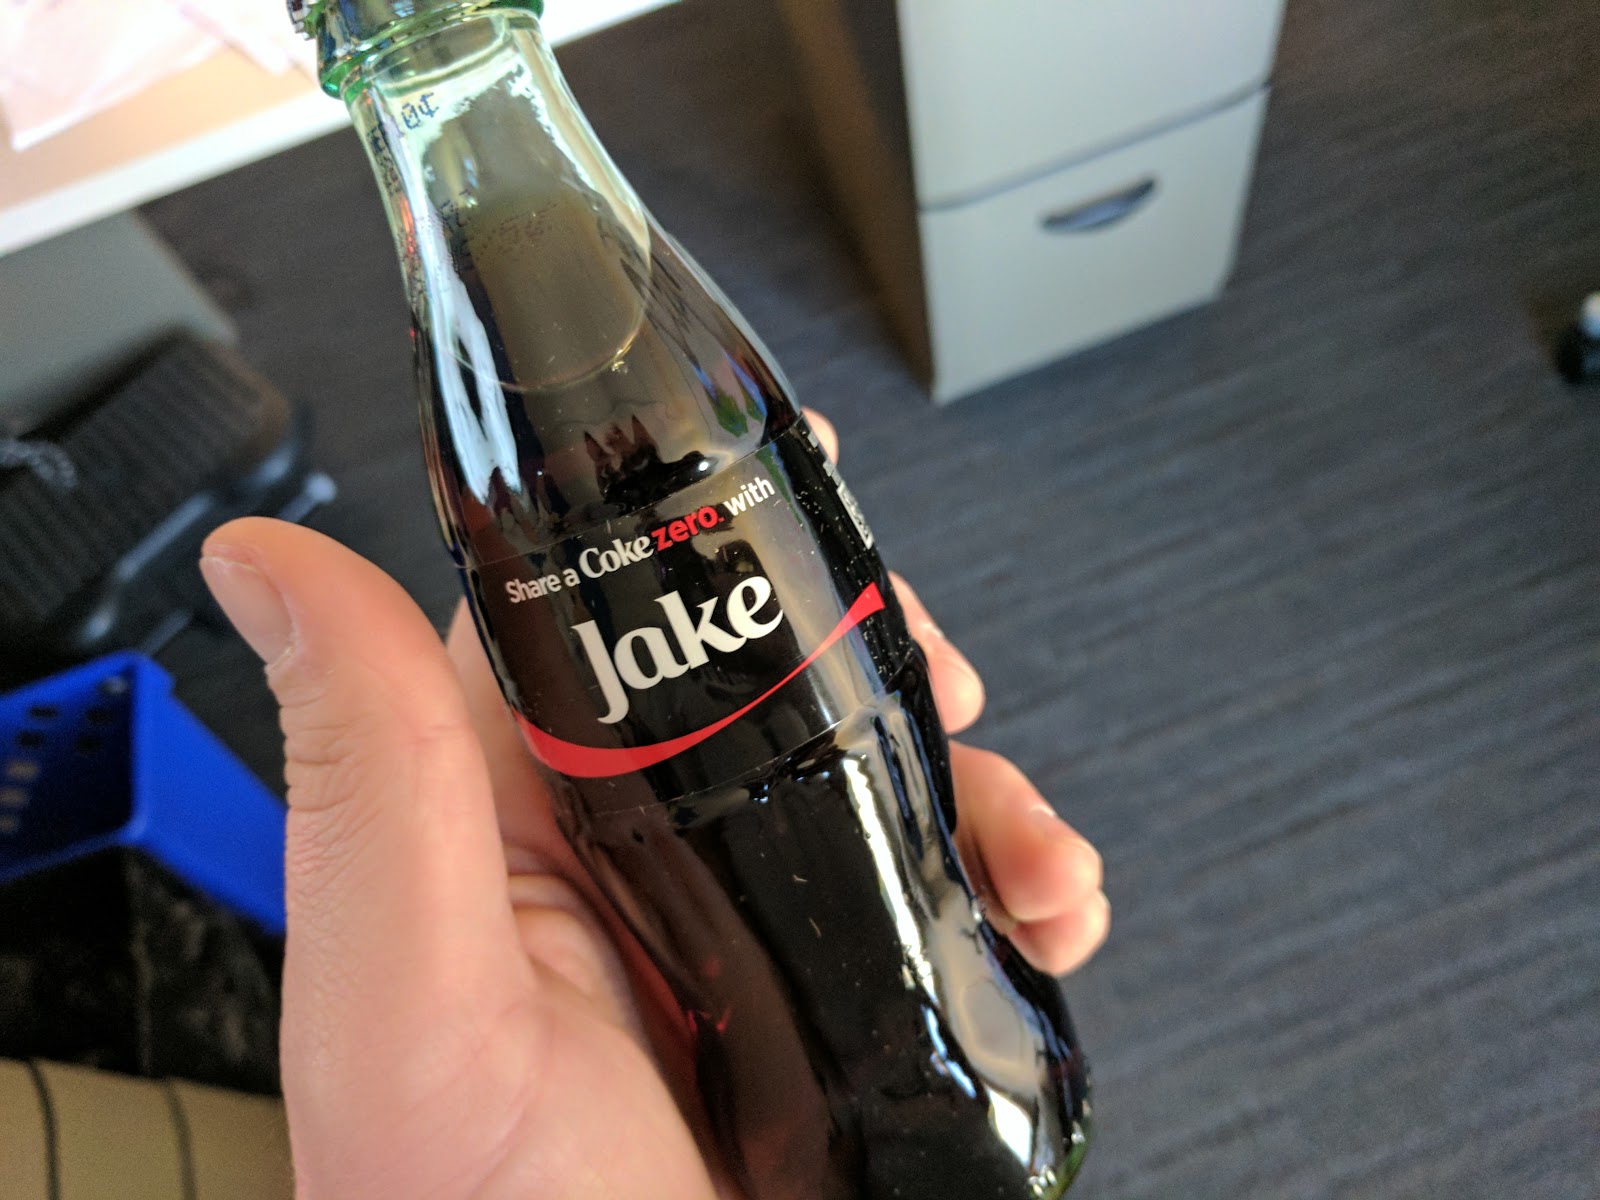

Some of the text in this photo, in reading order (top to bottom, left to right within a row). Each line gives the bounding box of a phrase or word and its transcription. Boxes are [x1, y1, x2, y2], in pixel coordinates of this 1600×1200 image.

[505, 573, 562, 604] Share
[562, 567, 582, 588] a
[578, 535, 655, 579] Coke
[723, 476, 776, 517] with
[570, 575, 784, 725] Jake
